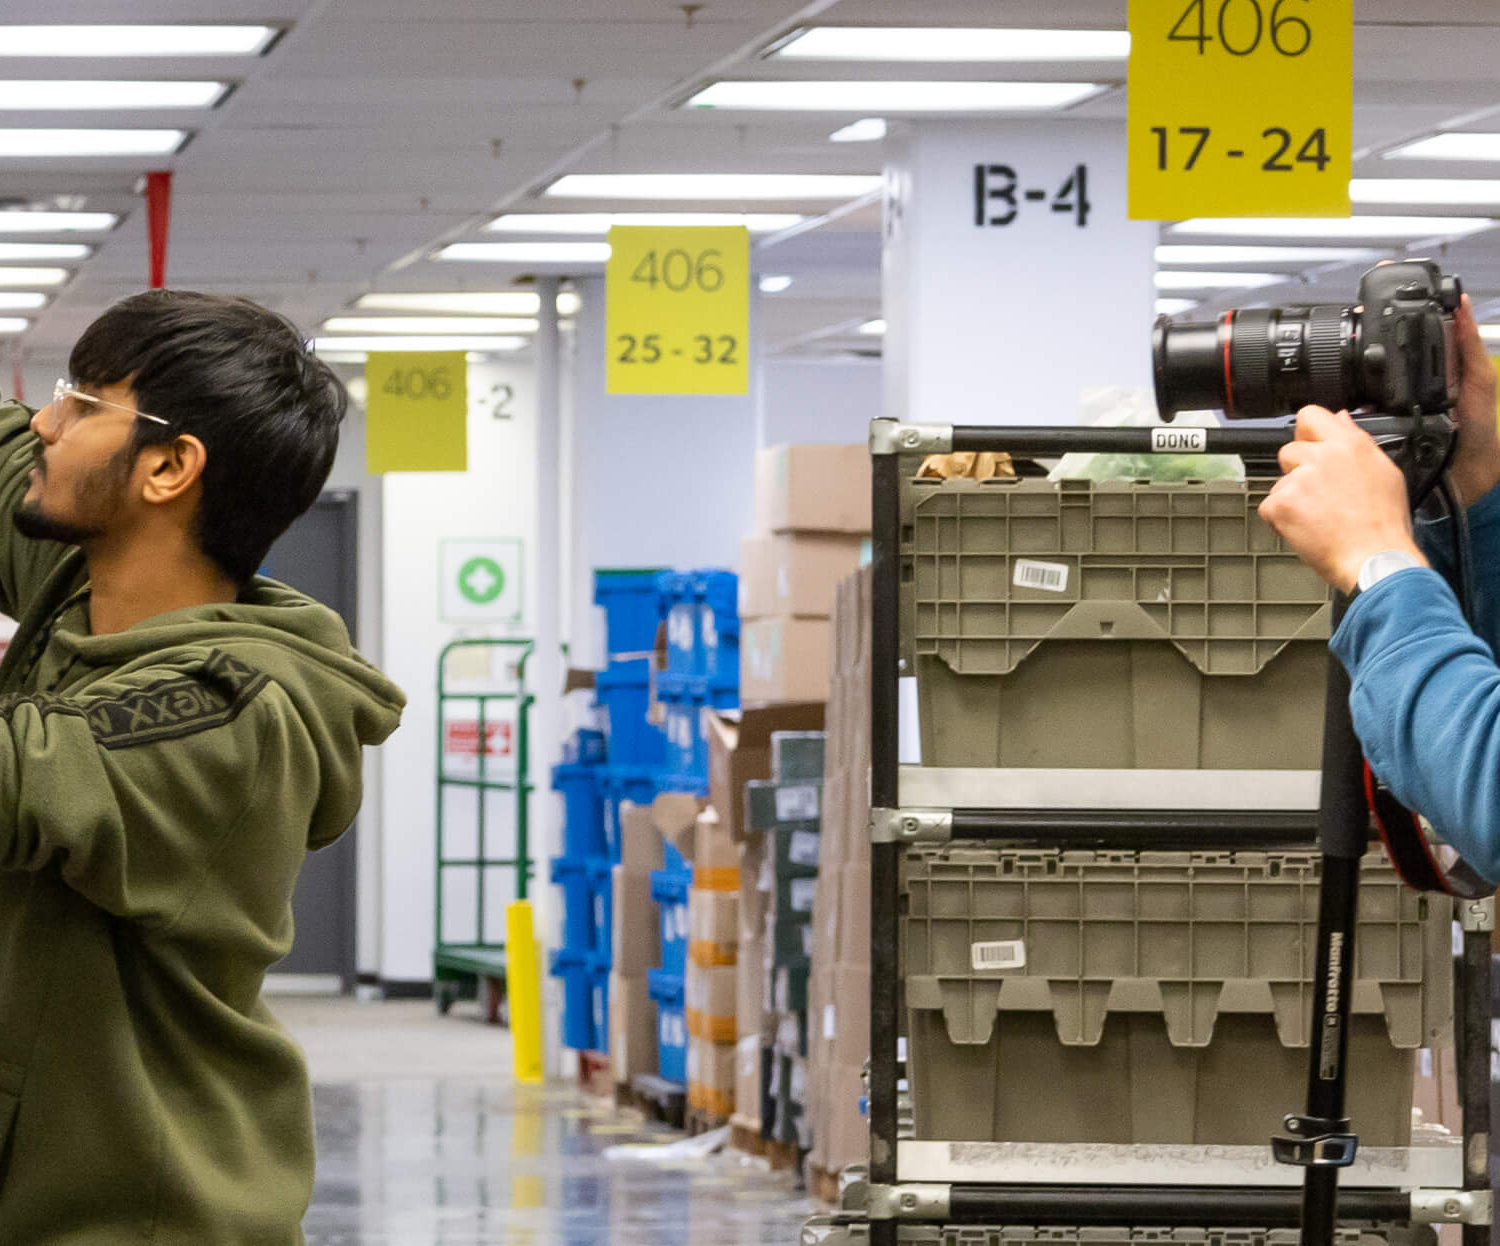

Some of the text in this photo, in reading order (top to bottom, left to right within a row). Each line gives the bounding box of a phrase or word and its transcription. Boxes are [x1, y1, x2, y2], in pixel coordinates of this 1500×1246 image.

[1167, 0, 1312, 57] 406
[1150, 127, 1211, 171] 17
[1261, 128, 1331, 171] 24
[975, 164, 1090, 228] B-4
[630, 248, 724, 291] 406
[617, 334, 662, 364] 25
[694, 335, 737, 364] 32
[383, 367, 452, 400] 406
[1156, 433, 1200, 448] DONC
[1325, 932, 1344, 1012] Manfrotto
